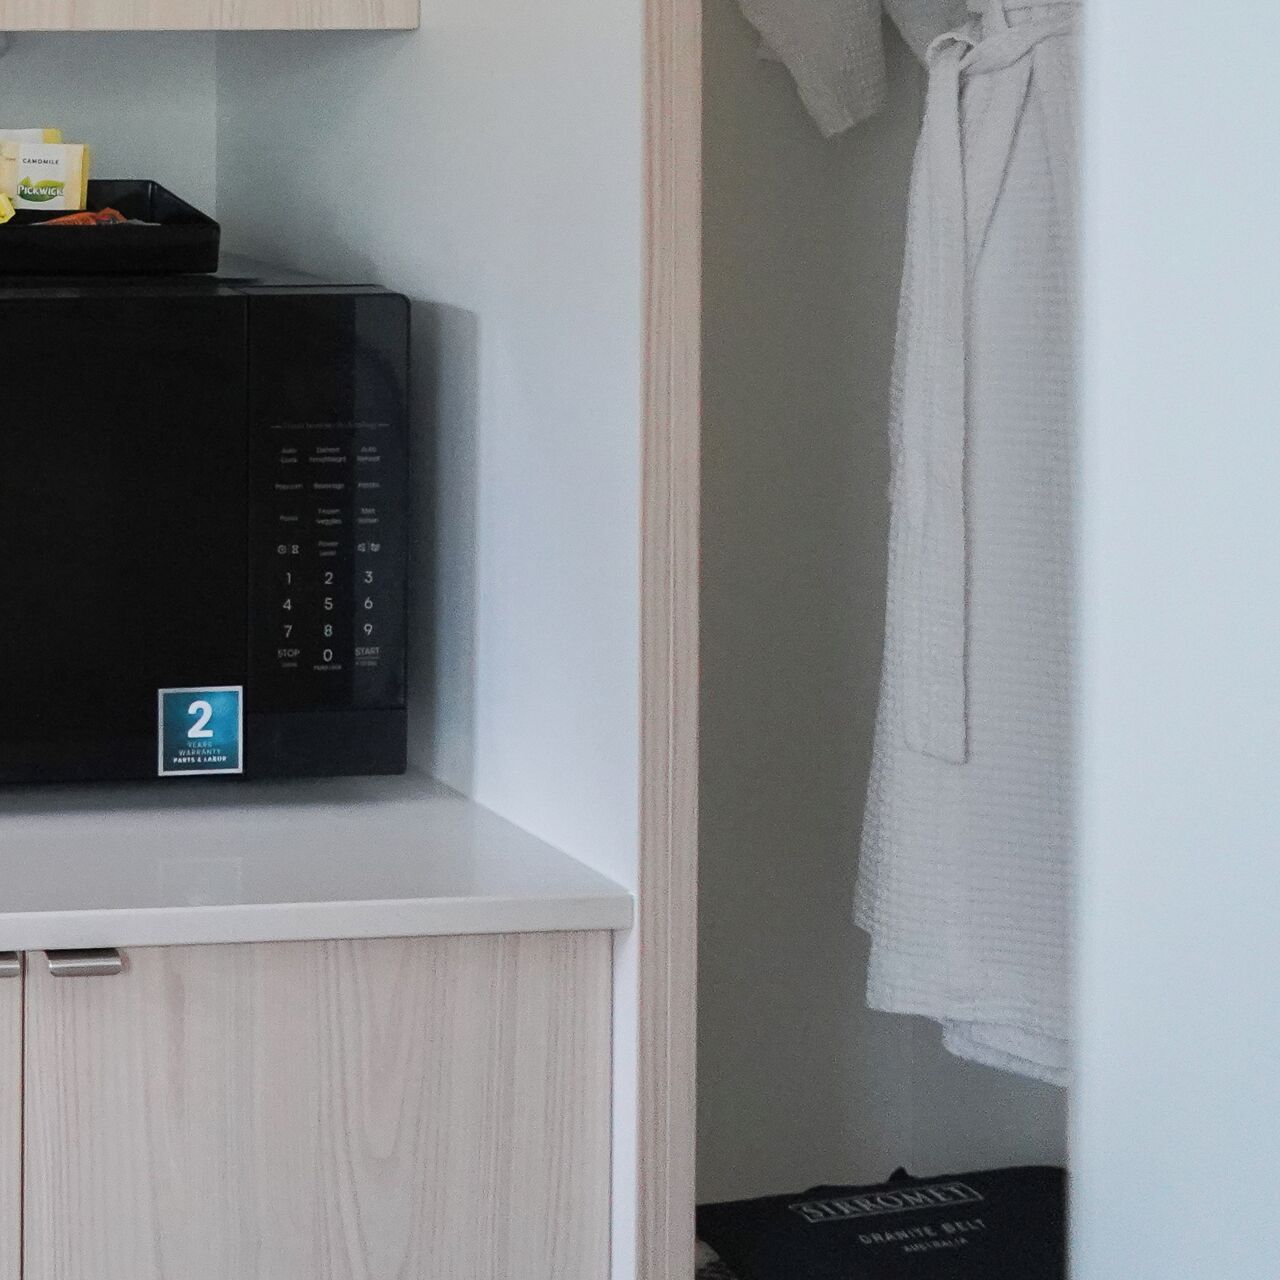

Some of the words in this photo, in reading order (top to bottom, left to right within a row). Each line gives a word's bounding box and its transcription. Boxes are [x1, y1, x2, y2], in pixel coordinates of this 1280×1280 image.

[16, 184, 66, 197] PICKWICK
[285, 571, 292, 586] 1
[324, 571, 334, 585] 2
[363, 570, 374, 584] 3
[281, 598, 293, 612] 4
[324, 596, 334, 611] 5
[363, 596, 374, 610] 6
[283, 623, 293, 639] 7
[323, 623, 333, 638] 8
[363, 622, 374, 637] 9
[277, 648, 301, 659] STOP
[322, 647, 334, 663] 0
[354, 646, 381, 657] START
[187, 699, 215, 739] 2
[173, 755, 196, 764] PARTS
[179, 748, 223, 757] WARRANTY
[800, 1185, 972, 1220] SIRROMET
[940, 1217, 987, 1235] BELT
